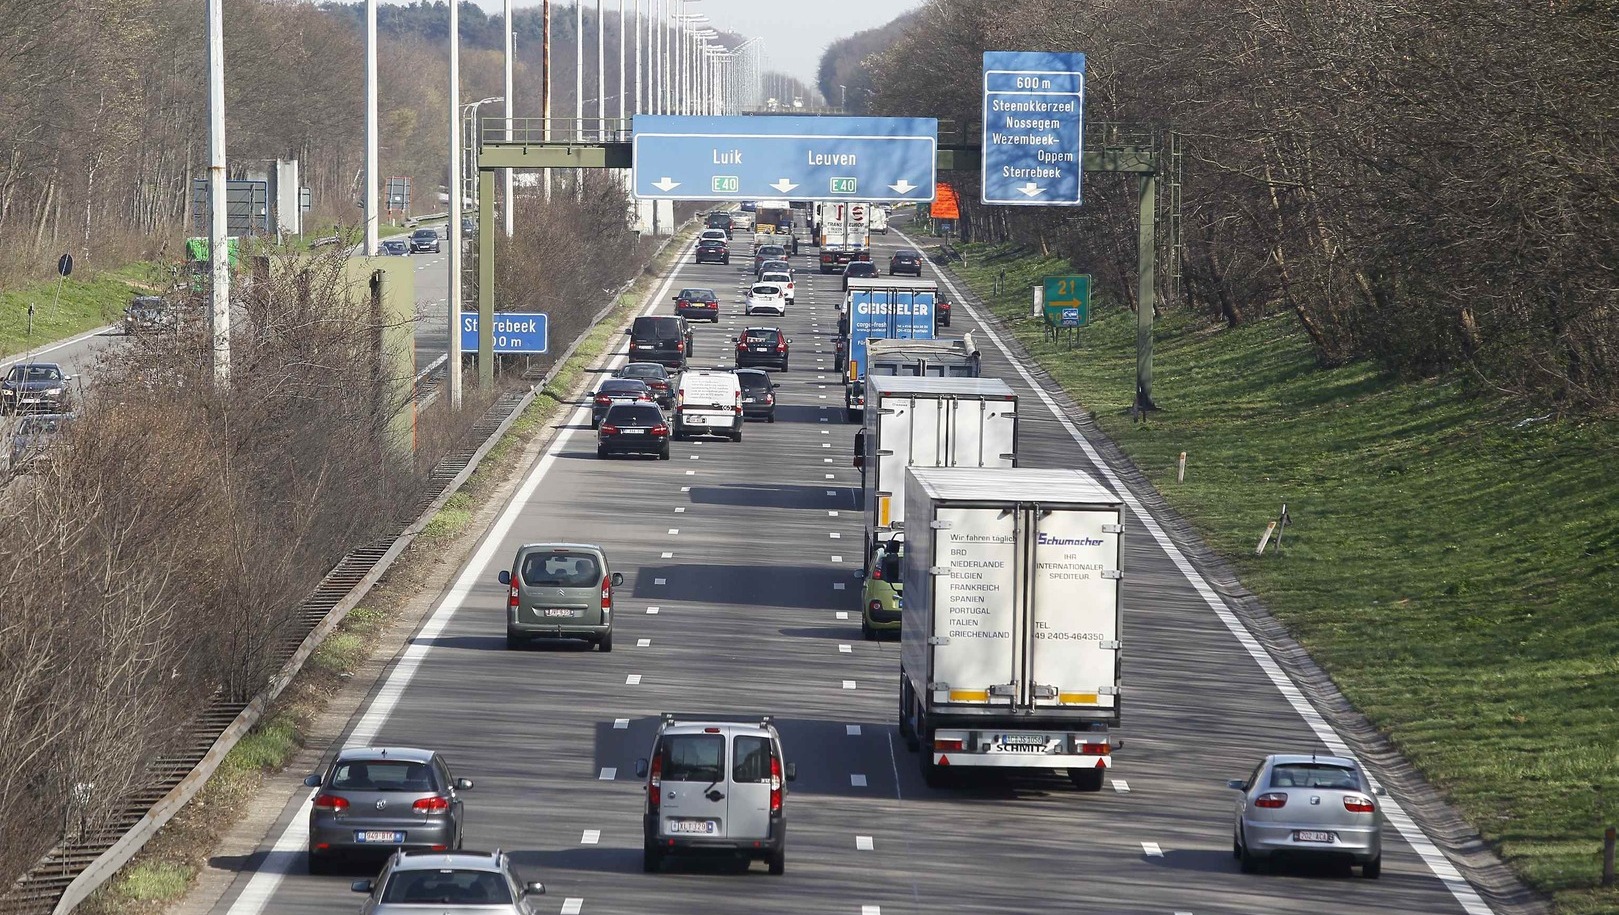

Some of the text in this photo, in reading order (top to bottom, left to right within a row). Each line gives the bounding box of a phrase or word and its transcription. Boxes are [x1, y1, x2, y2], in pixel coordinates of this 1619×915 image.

[1017, 77, 1051, 89] 600 m
[992, 100, 1074, 112] Steenokkerzeel
[1006, 116, 1060, 131] Nossegem
[992, 133, 1060, 145] Wezembeek-
[713, 148, 856, 166] Luik Leuven
[1038, 150, 1073, 164] Oppem
[1003, 166, 1061, 178] Sterrebeek
[1058, 280, 1075, 294] 21
[858, 302, 928, 316] GEISSELER
[464, 318, 536, 332] Strebeek
[510, 338, 522, 346] m
[950, 534, 965, 542] Wir
[966, 534, 990, 542] fahren
[1038, 532, 1104, 546] Schumacher
[1036, 562, 1104, 571] INTERNATIONALER
[1036, 622, 1050, 630] TEL.
[950, 630, 1010, 639] GRIECHENLAND
[996, 743, 1048, 753] SCHMITZ
